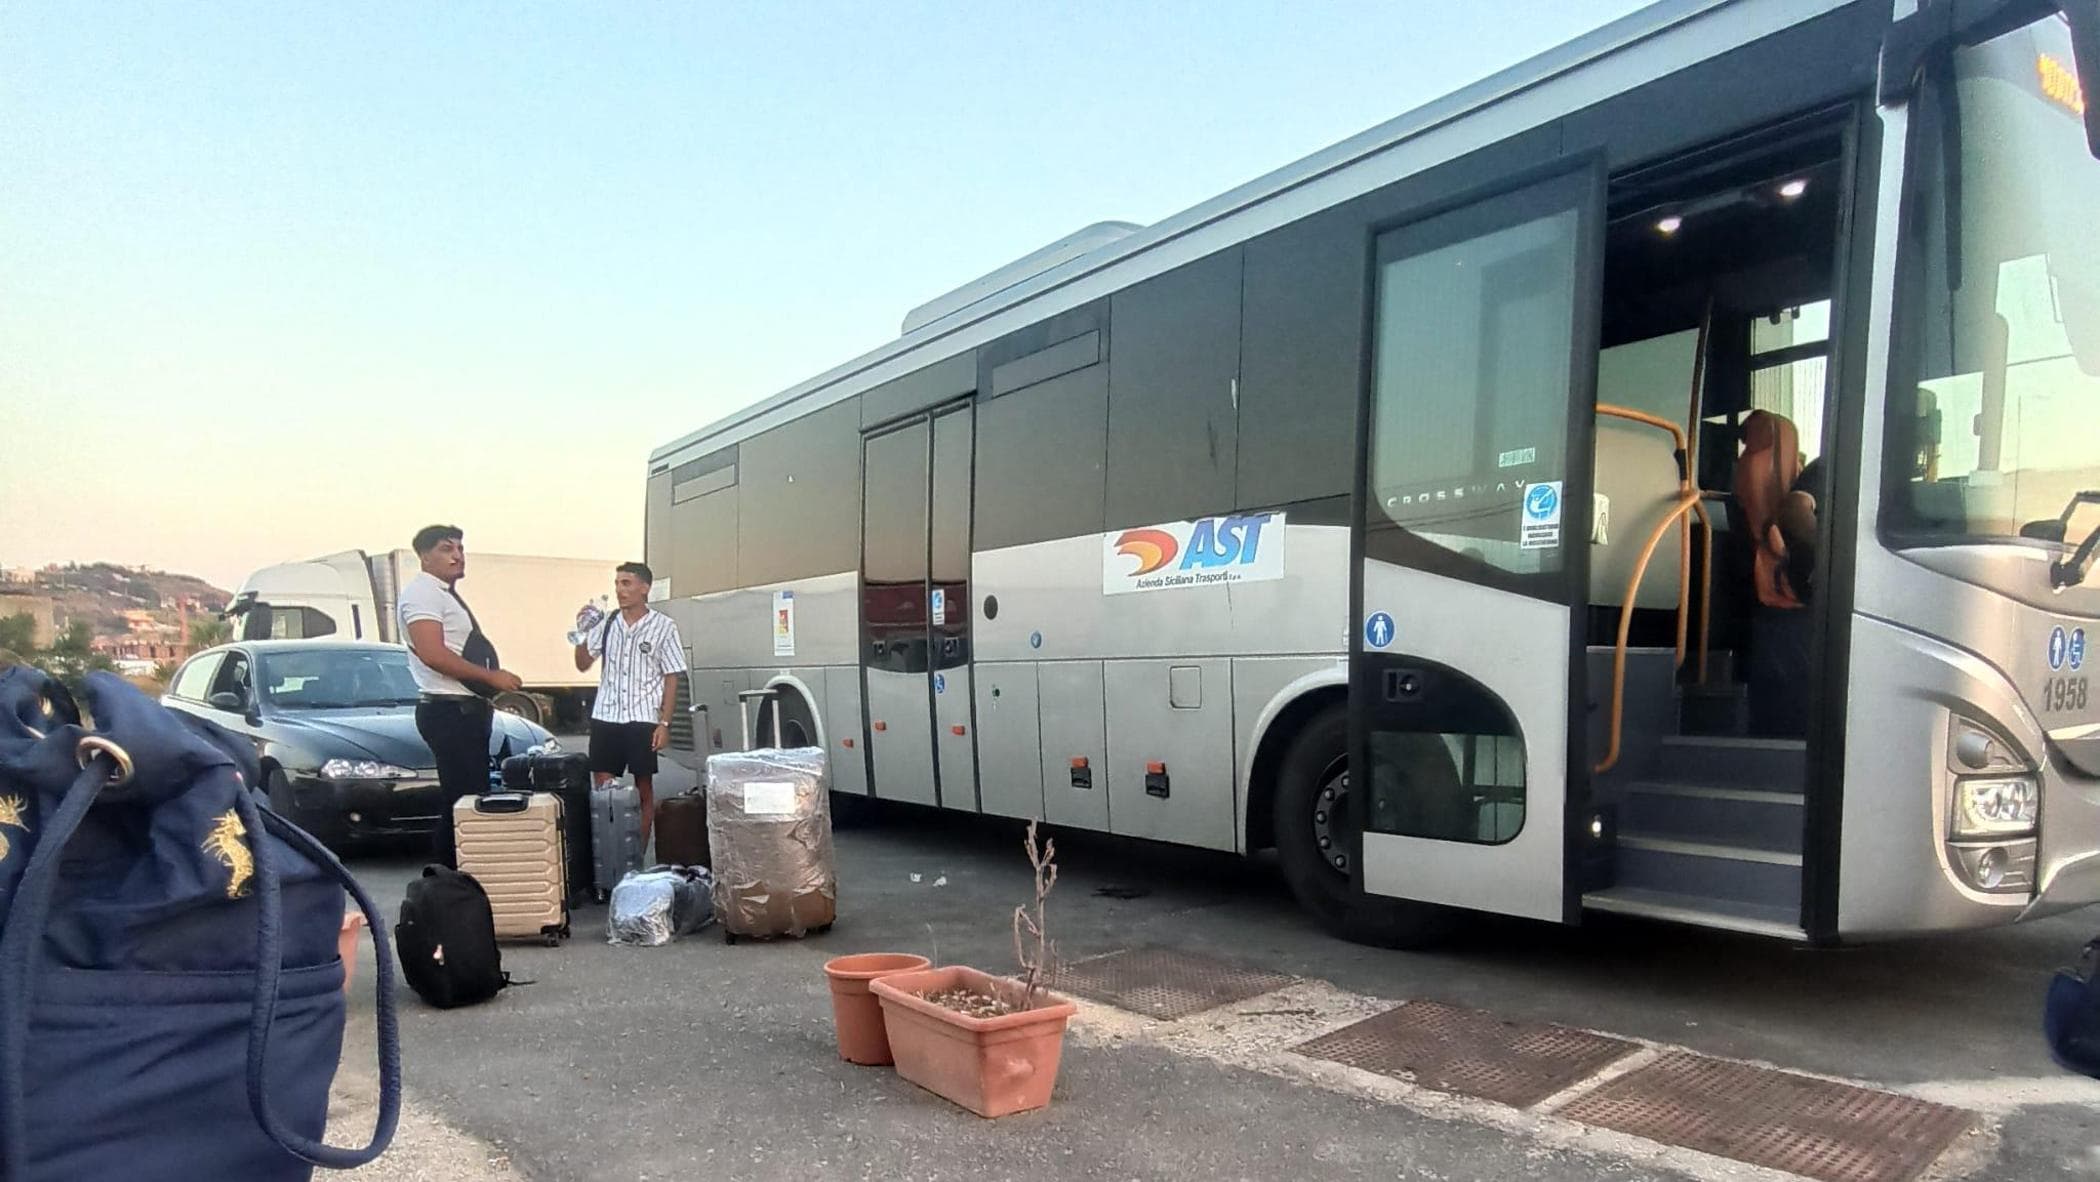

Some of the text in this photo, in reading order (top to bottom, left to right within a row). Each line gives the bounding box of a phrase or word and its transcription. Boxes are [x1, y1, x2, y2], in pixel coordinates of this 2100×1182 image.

[1180, 513, 1271, 569] AST
[1136, 579, 1164, 589] Azienda
[1165, 574, 1194, 586] Siciliana
[1195, 570, 1229, 583] Trasporti
[2043, 677, 2087, 712] 1958
